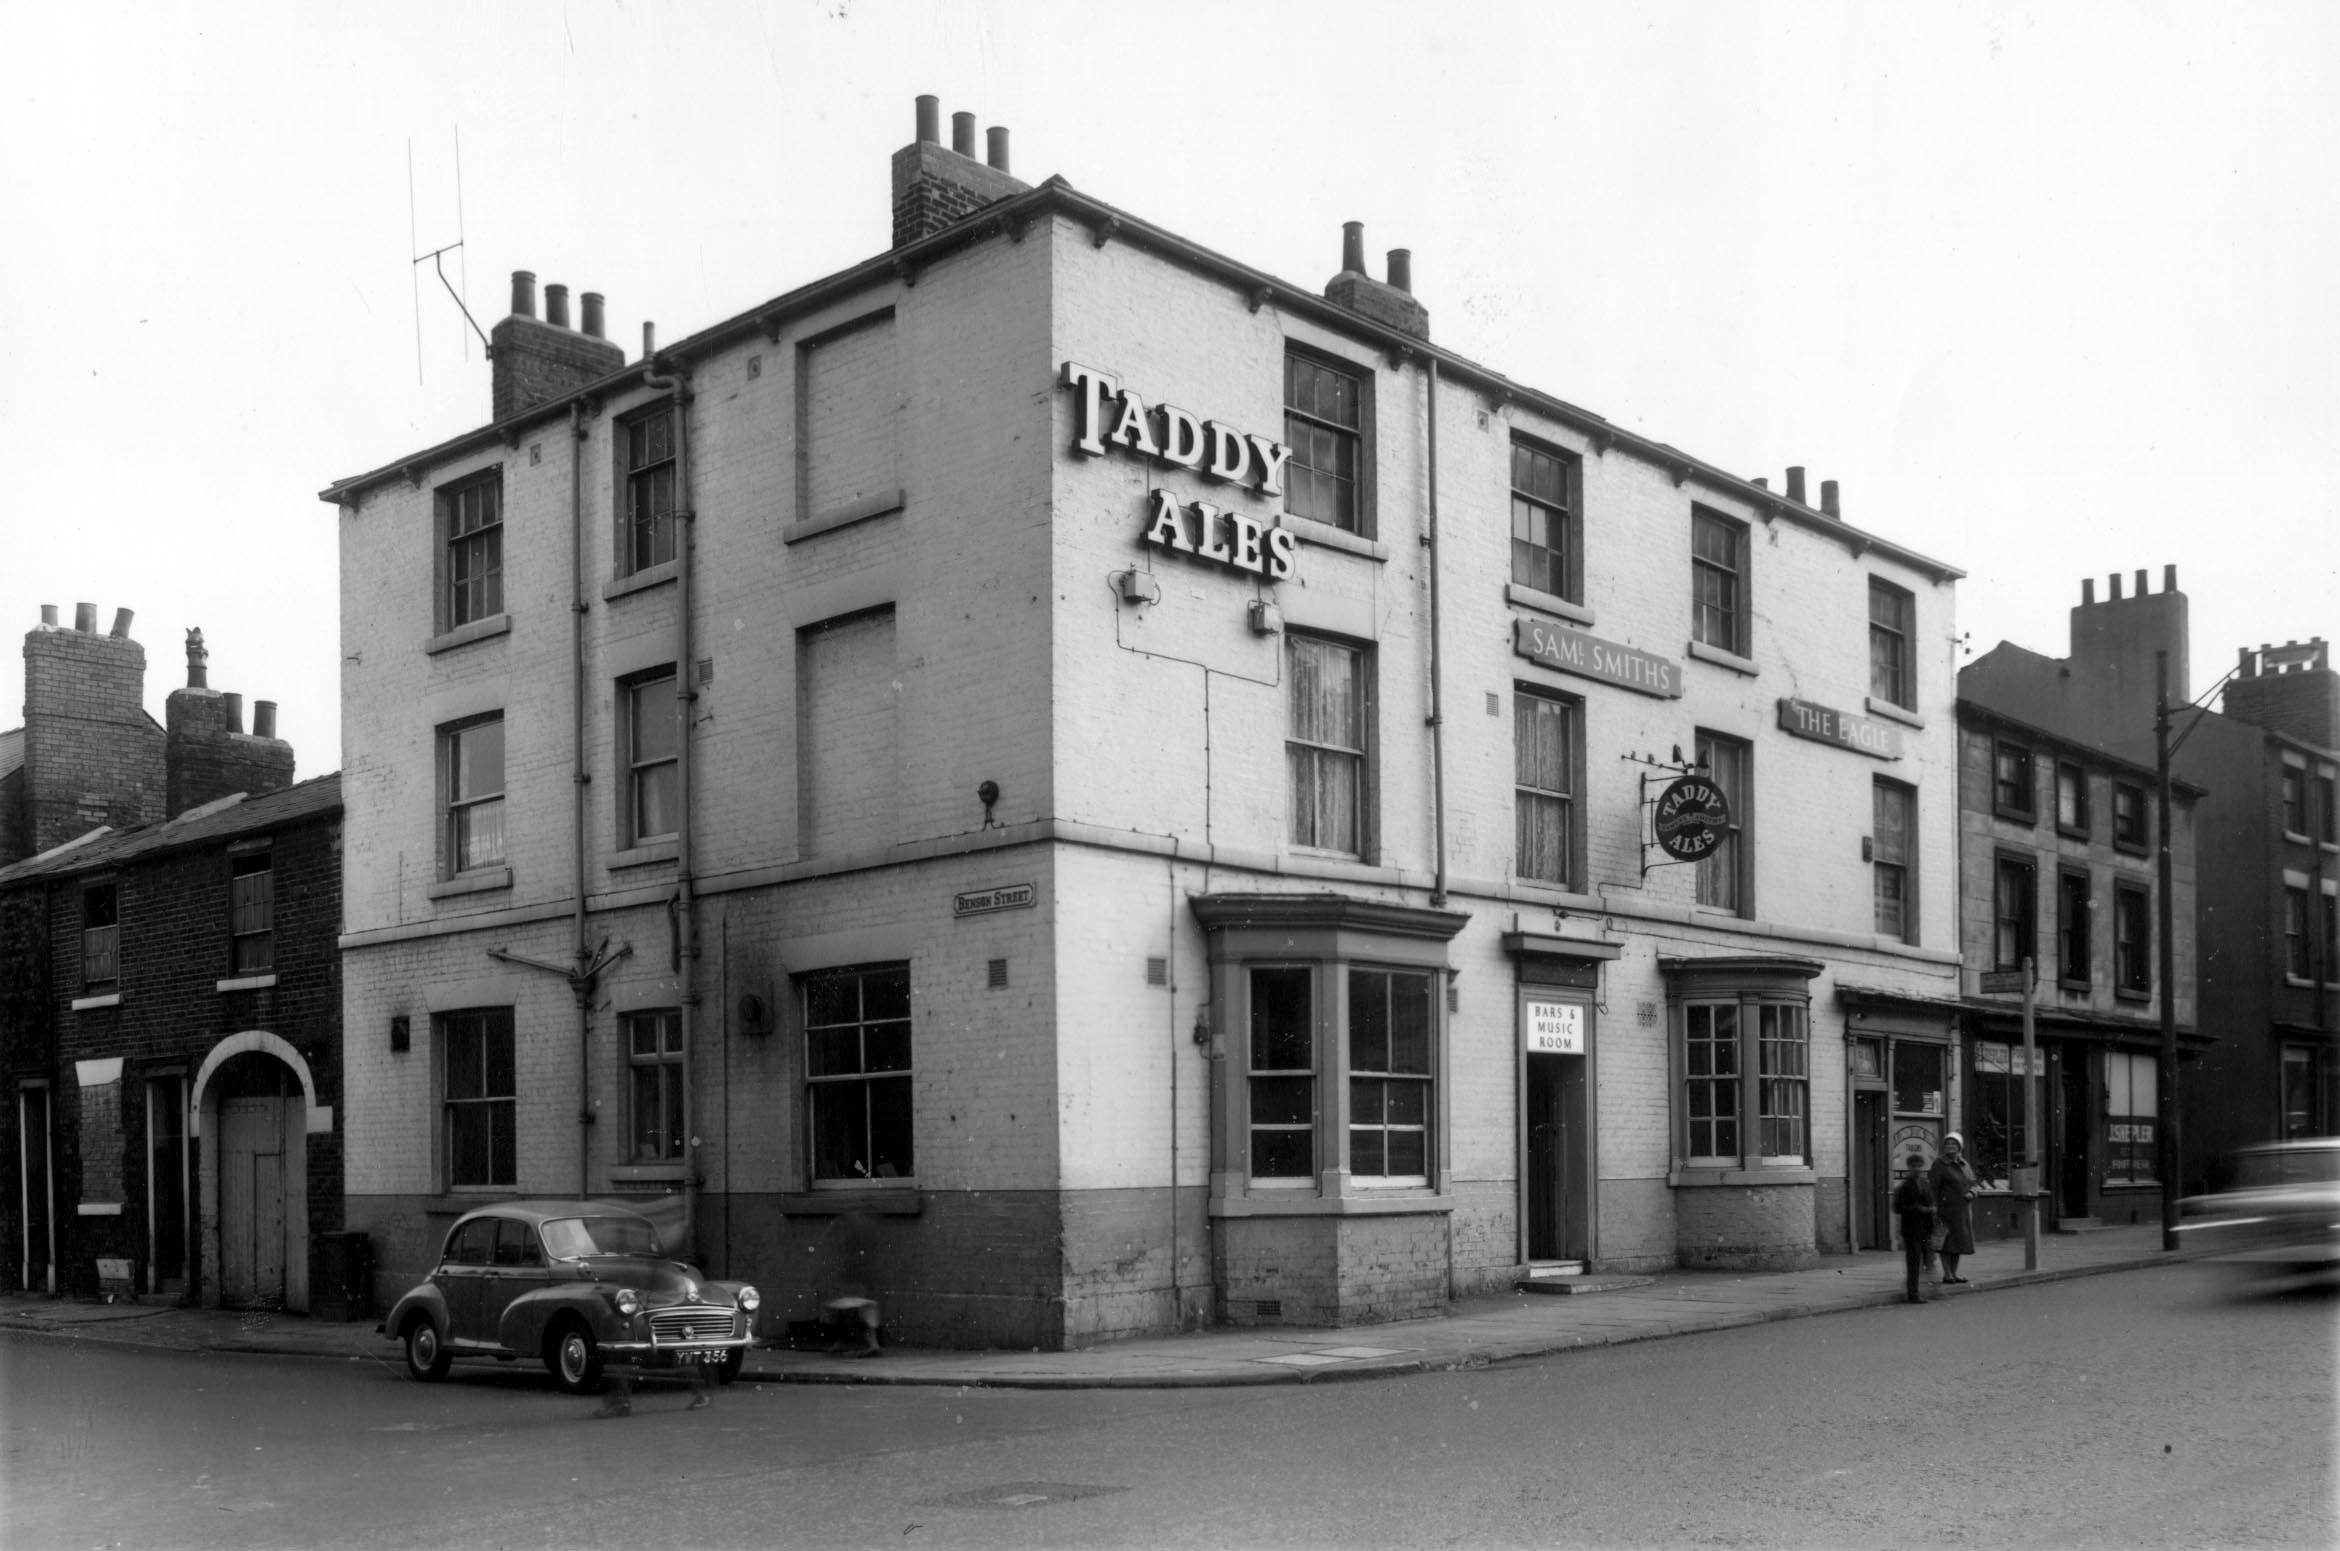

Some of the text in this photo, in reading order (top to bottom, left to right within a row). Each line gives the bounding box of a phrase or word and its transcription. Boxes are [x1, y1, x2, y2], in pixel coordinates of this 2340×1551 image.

[1061, 361, 1293, 497] TADDY
[1147, 488, 1295, 581] ALES
[1593, 645, 1670, 690] SMITHS
[1797, 705, 1889, 753] THE EAGLE
[1662, 784, 1721, 816] TADDY
[1669, 828, 1715, 853] ALES
[993, 890, 1030, 905] STREET
[1534, 1005, 1576, 1020] BARS &
[1537, 1021, 1573, 1035] MUSIC
[1539, 1036, 1573, 1049] ROOM
